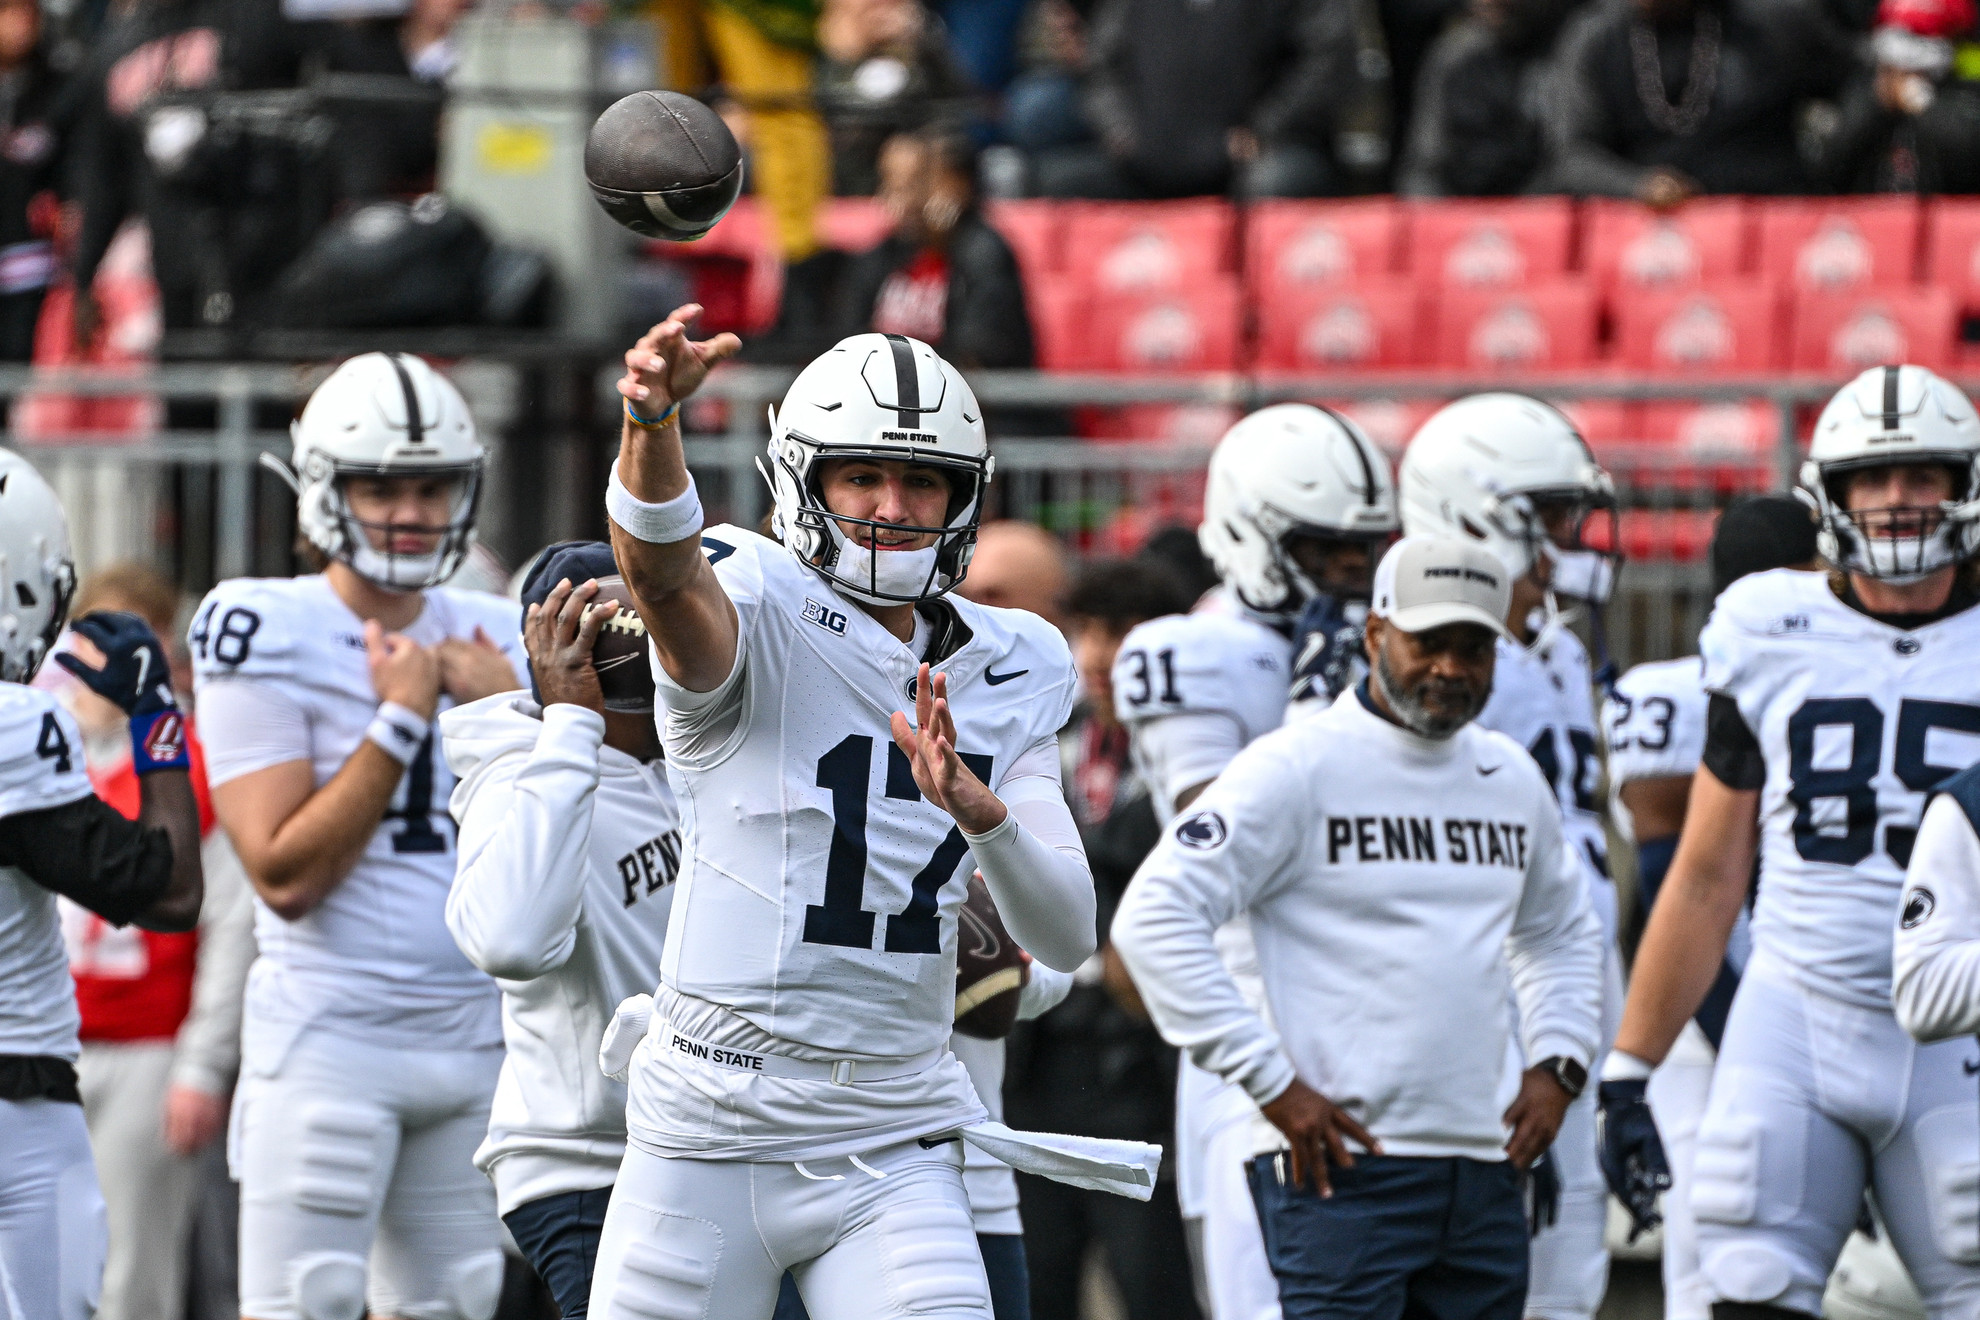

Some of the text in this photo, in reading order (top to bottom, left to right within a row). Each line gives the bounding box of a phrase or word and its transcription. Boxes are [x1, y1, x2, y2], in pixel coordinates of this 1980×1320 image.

[881, 431, 938, 444] PENN STATE
[192, 601, 261, 667] 48
[1121, 648, 1183, 707] 31
[36, 711, 72, 773] 4
[617, 829, 683, 909] PEN
[802, 733, 995, 954] 17
[1328, 816, 1526, 870] PENN STATE
[672, 1034, 764, 1070] PENN STATE
